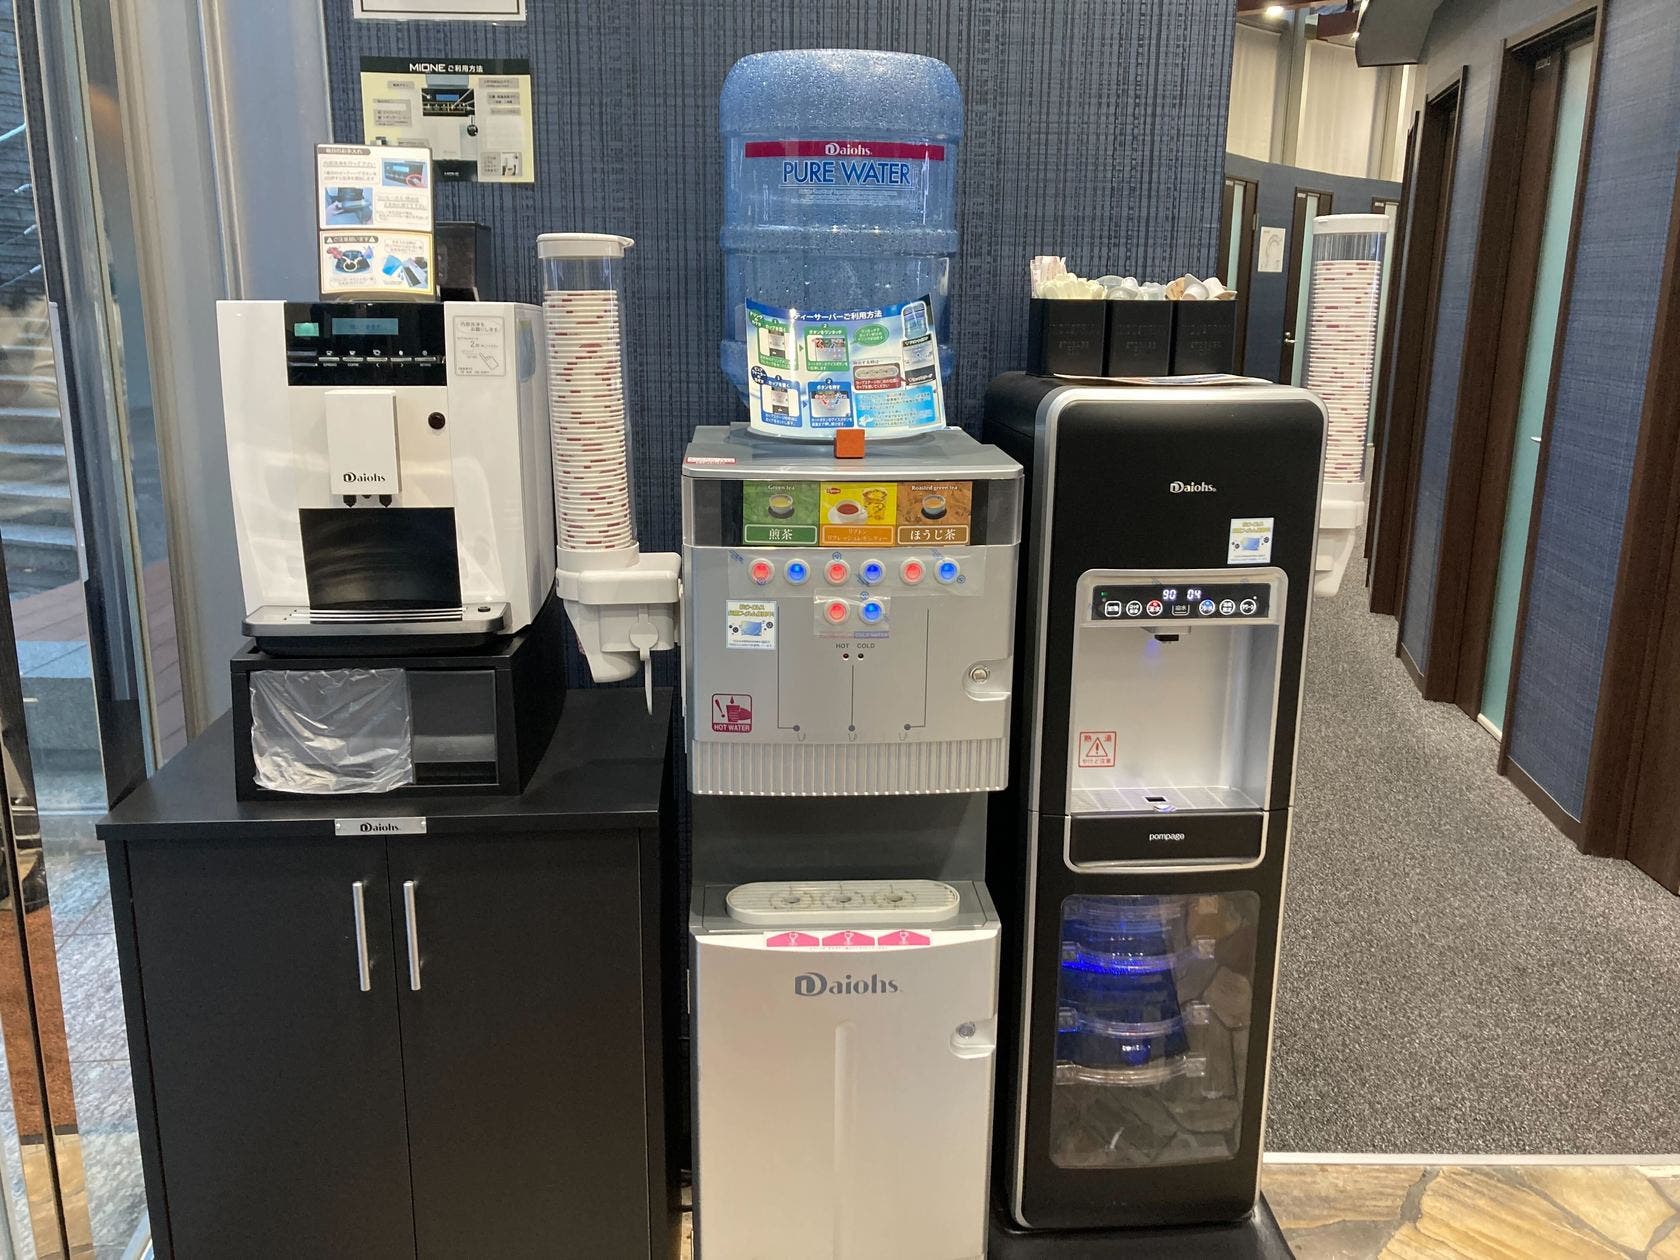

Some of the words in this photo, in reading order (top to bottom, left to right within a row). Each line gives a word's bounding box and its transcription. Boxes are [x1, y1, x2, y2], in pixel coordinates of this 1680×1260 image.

[409, 63, 446, 72] MIONE
[825, 142, 871, 156] Daiohs
[783, 160, 835, 184] PURE
[841, 160, 912, 185] WATER
[343, 471, 386, 483] Daiohs
[1169, 480, 1214, 493] Daiohs
[768, 528, 793, 541] 煎茶
[910, 528, 956, 541] ほうじ茶
[1162, 588, 1177, 600] 90
[1186, 588, 1202, 600] 04
[728, 724, 750, 732] WATER
[360, 822, 400, 832] Daiohs
[1149, 833, 1185, 842] pompage
[794, 971, 899, 997] Daiohs
